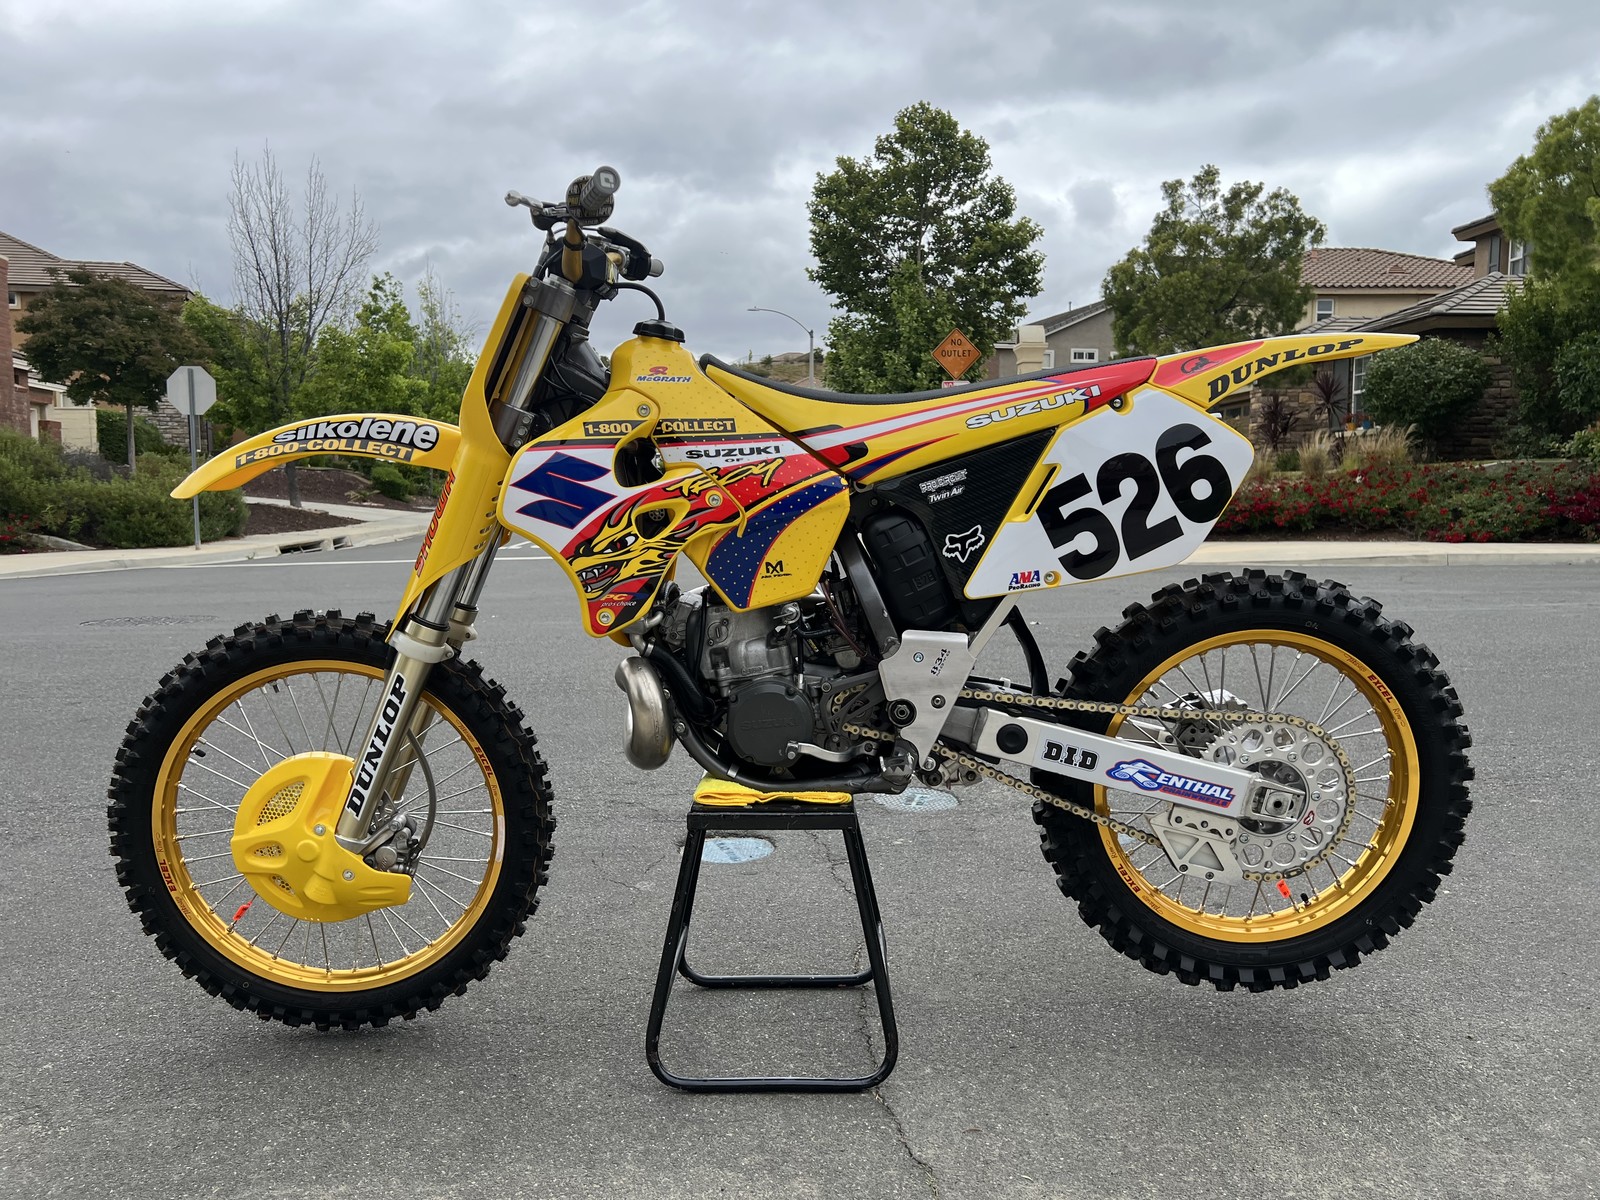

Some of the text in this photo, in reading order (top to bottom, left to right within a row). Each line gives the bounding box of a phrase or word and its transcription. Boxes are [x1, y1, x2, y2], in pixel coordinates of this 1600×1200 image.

[1208, 338, 1363, 402] DUNLOP
[966, 385, 1101, 429] SUZUKI
[585, 422, 632, 434] 1-800
[236, 438, 411, 466] 1-800-COLLECT
[685, 445, 781, 459] SUZUKI
[929, 486, 964, 503] Twin Air
[1037, 423, 1232, 580] 526
[415, 467, 456, 578] SHOWA
[1009, 570, 1040, 585] AMA
[1367, 674, 1394, 703] EXCEL
[347, 674, 407, 818] DUNLOP
[474, 746, 493, 778] EXCEL
[160, 859, 176, 892] EXCEL
[1118, 864, 1141, 893] EXCEL
